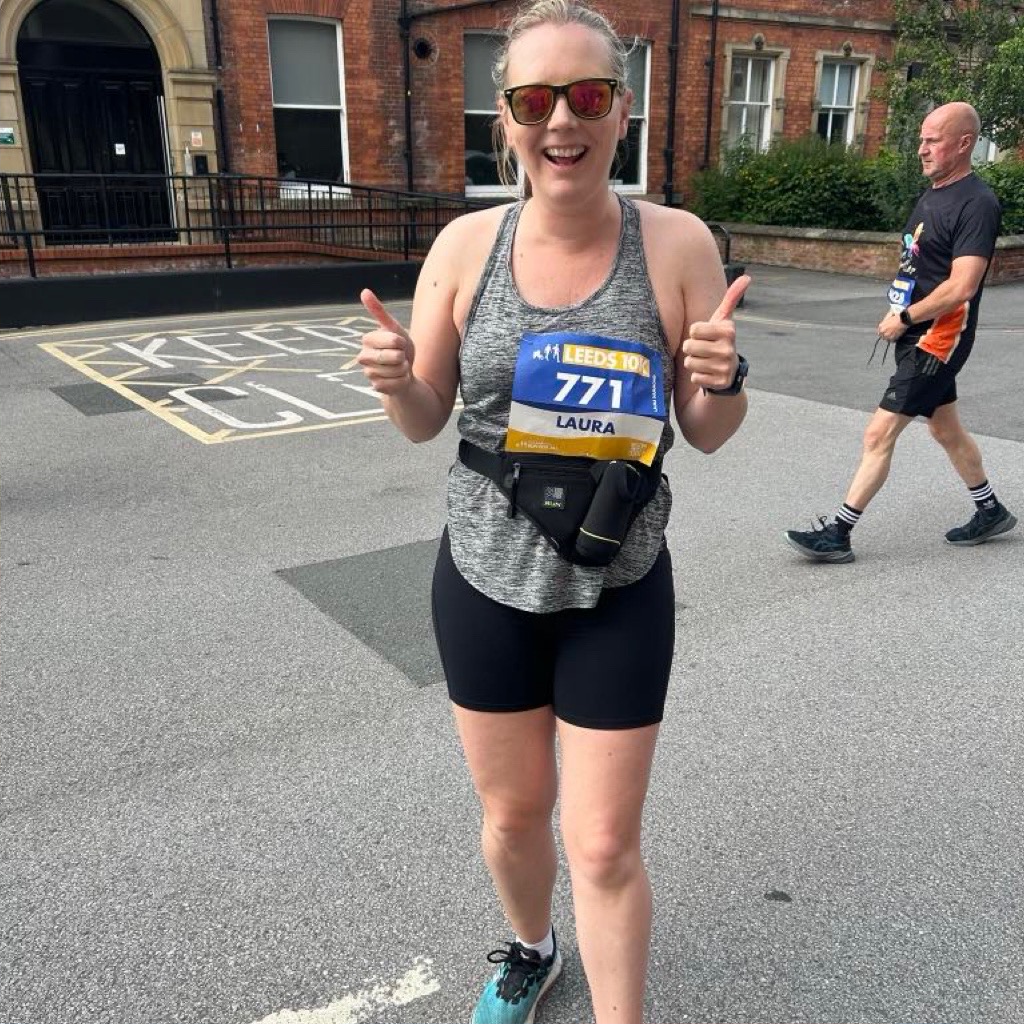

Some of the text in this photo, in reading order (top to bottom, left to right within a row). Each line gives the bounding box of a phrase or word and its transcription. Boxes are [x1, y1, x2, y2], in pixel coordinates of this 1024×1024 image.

[564, 349, 617, 368] LEEDS
[553, 371, 624, 409] 771
[556, 415, 616, 435] LAURA
